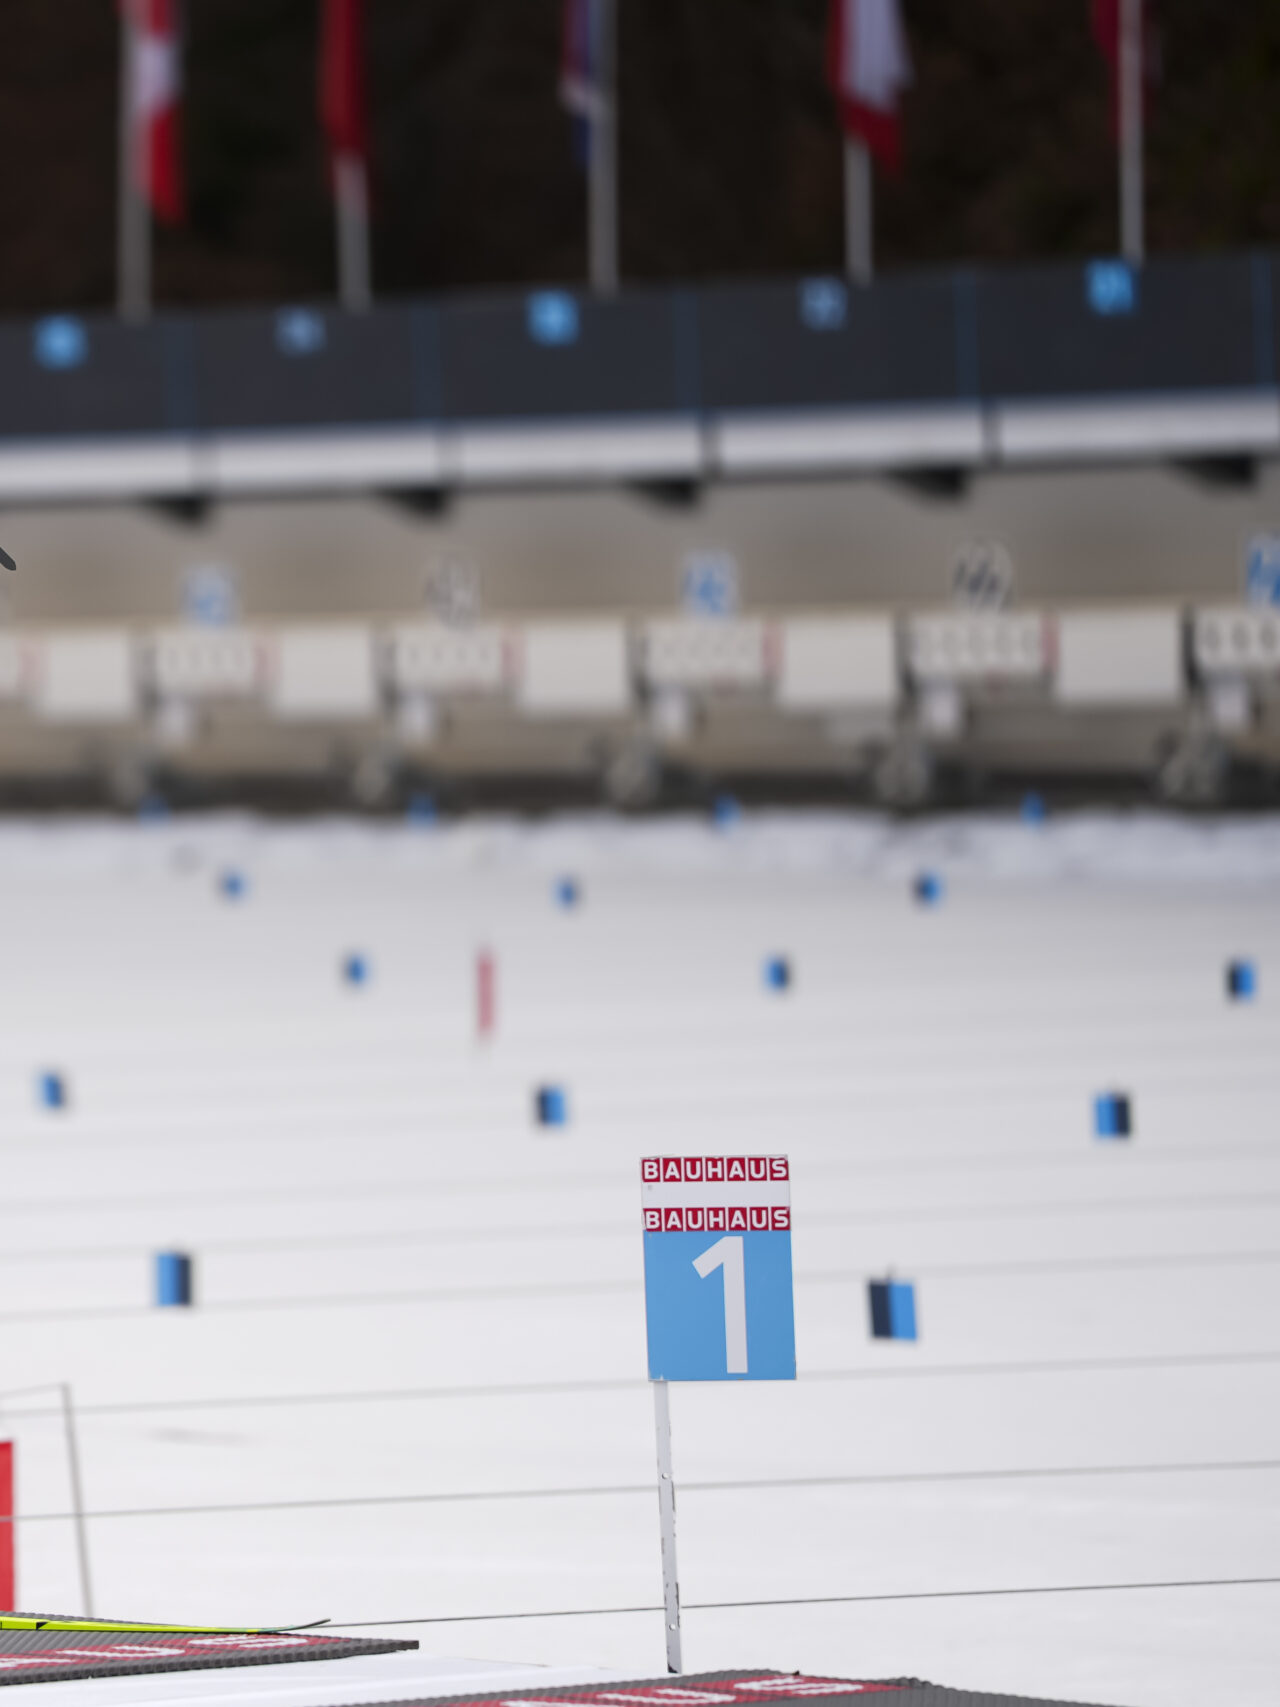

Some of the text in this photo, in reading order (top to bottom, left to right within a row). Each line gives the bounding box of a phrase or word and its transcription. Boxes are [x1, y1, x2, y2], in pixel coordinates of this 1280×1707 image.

[644, 1159, 788, 1180] BAUHAUS
[646, 1209, 789, 1230] BAUHAUS
[692, 1236, 748, 1374] 1
